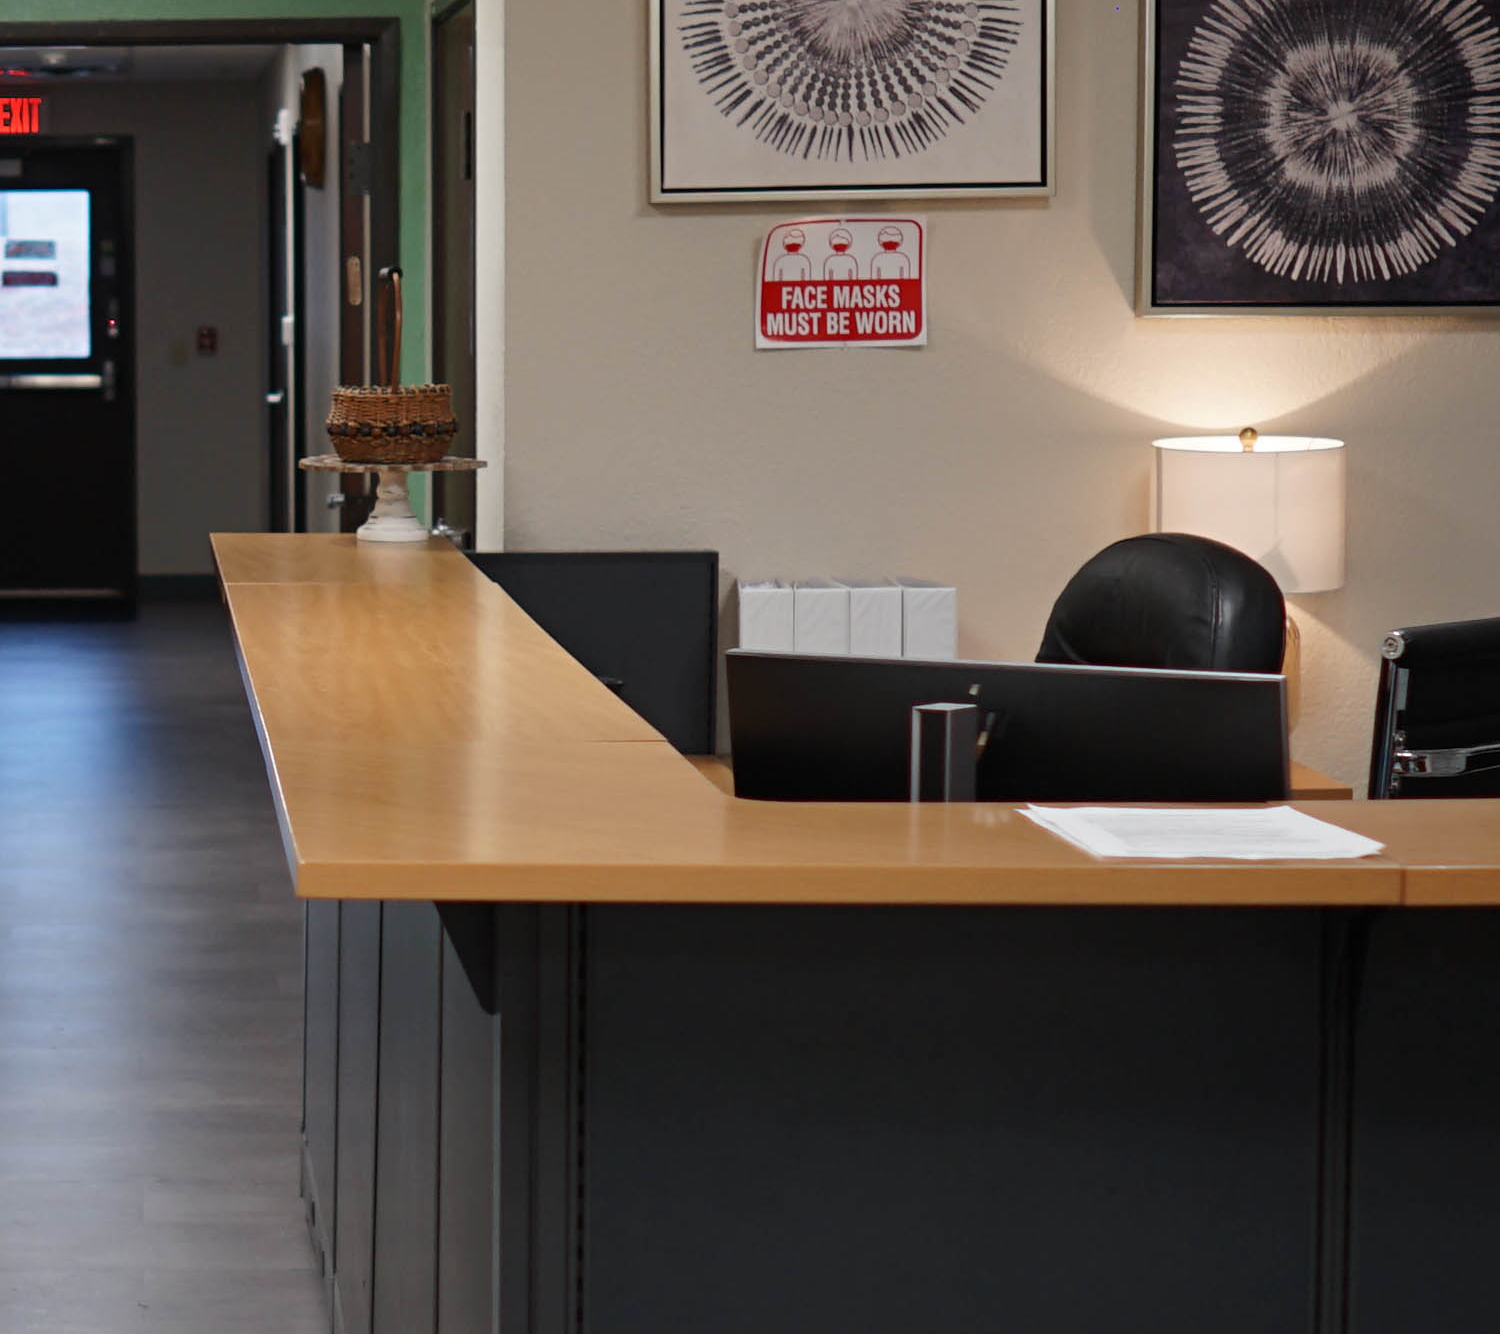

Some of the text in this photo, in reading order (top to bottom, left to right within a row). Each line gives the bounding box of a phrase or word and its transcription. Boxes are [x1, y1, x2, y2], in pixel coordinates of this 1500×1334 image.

[781, 284, 901, 310] FACE MASKS
[766, 310, 916, 336] MUST BE WORN
